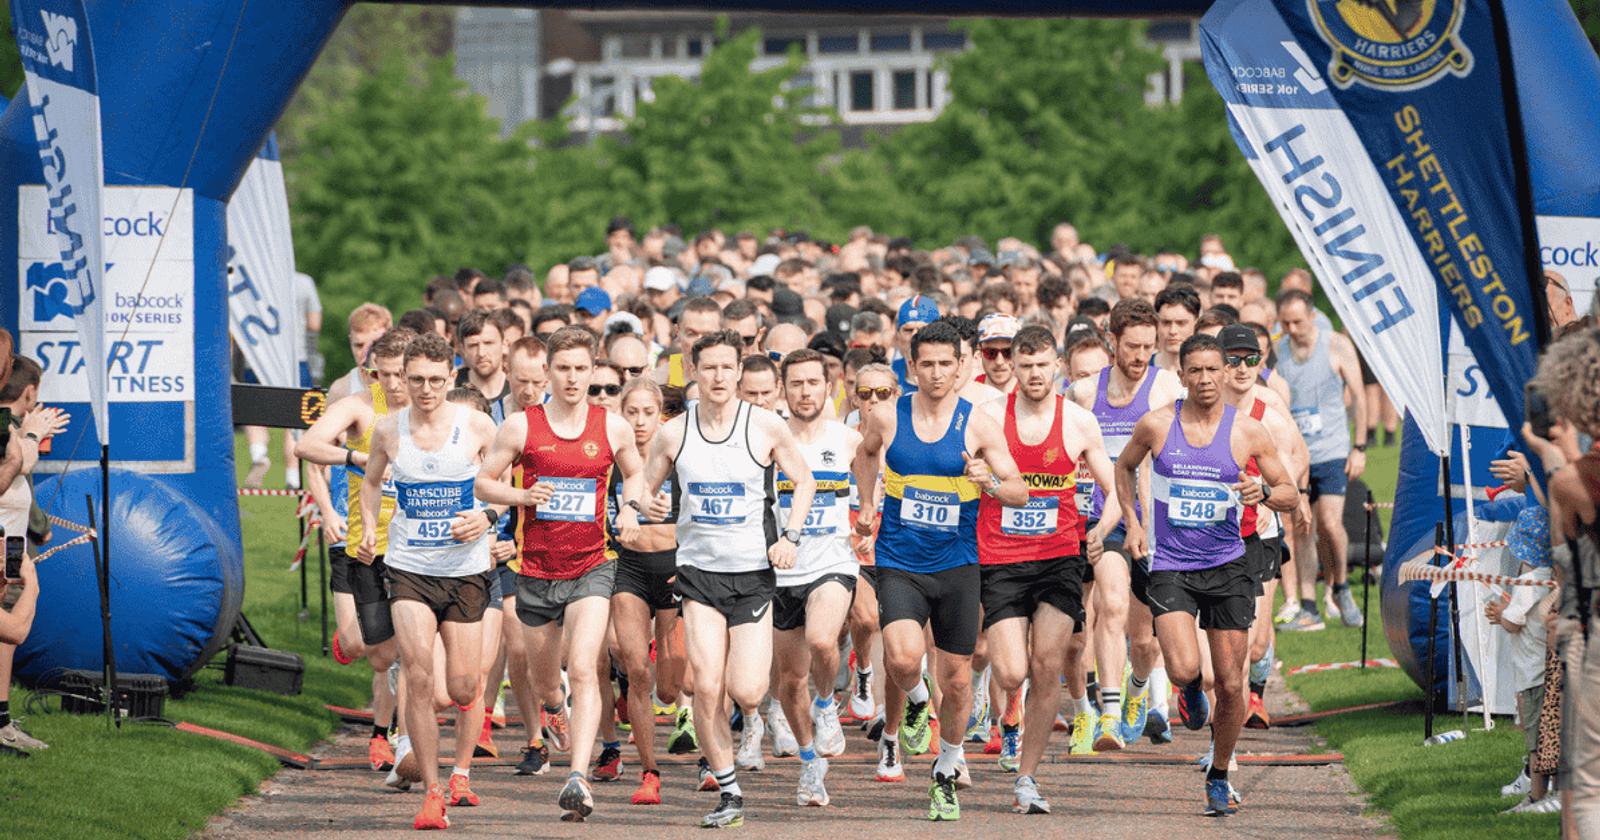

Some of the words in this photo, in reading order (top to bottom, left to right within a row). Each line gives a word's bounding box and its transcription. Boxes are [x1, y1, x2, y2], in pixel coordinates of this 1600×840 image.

[1354, 30, 1436, 59] HARRIERS
[1394, 104, 1531, 347] SHETTLESTON
[1386, 155, 1485, 330] HARRIERS
[1541, 241, 1598, 267] cock
[115, 292, 183, 308] babcock
[136, 313, 182, 324] SERIES
[553, 480, 585, 490] abcock
[698, 484, 733, 494] babcock
[1022, 474, 1068, 488] NOWAY
[405, 487, 463, 498] GARSCUBE
[914, 490, 949, 503] babcock
[1181, 488, 1217, 498] babcock
[406, 498, 462, 508] HARRIERS
[549, 493, 584, 512] 527
[701, 498, 734, 515] 467
[1180, 501, 1216, 519] 548
[416, 509, 450, 518] babcock
[911, 503, 949, 523] 310
[1012, 511, 1047, 527] 352
[417, 522, 452, 538] 452
